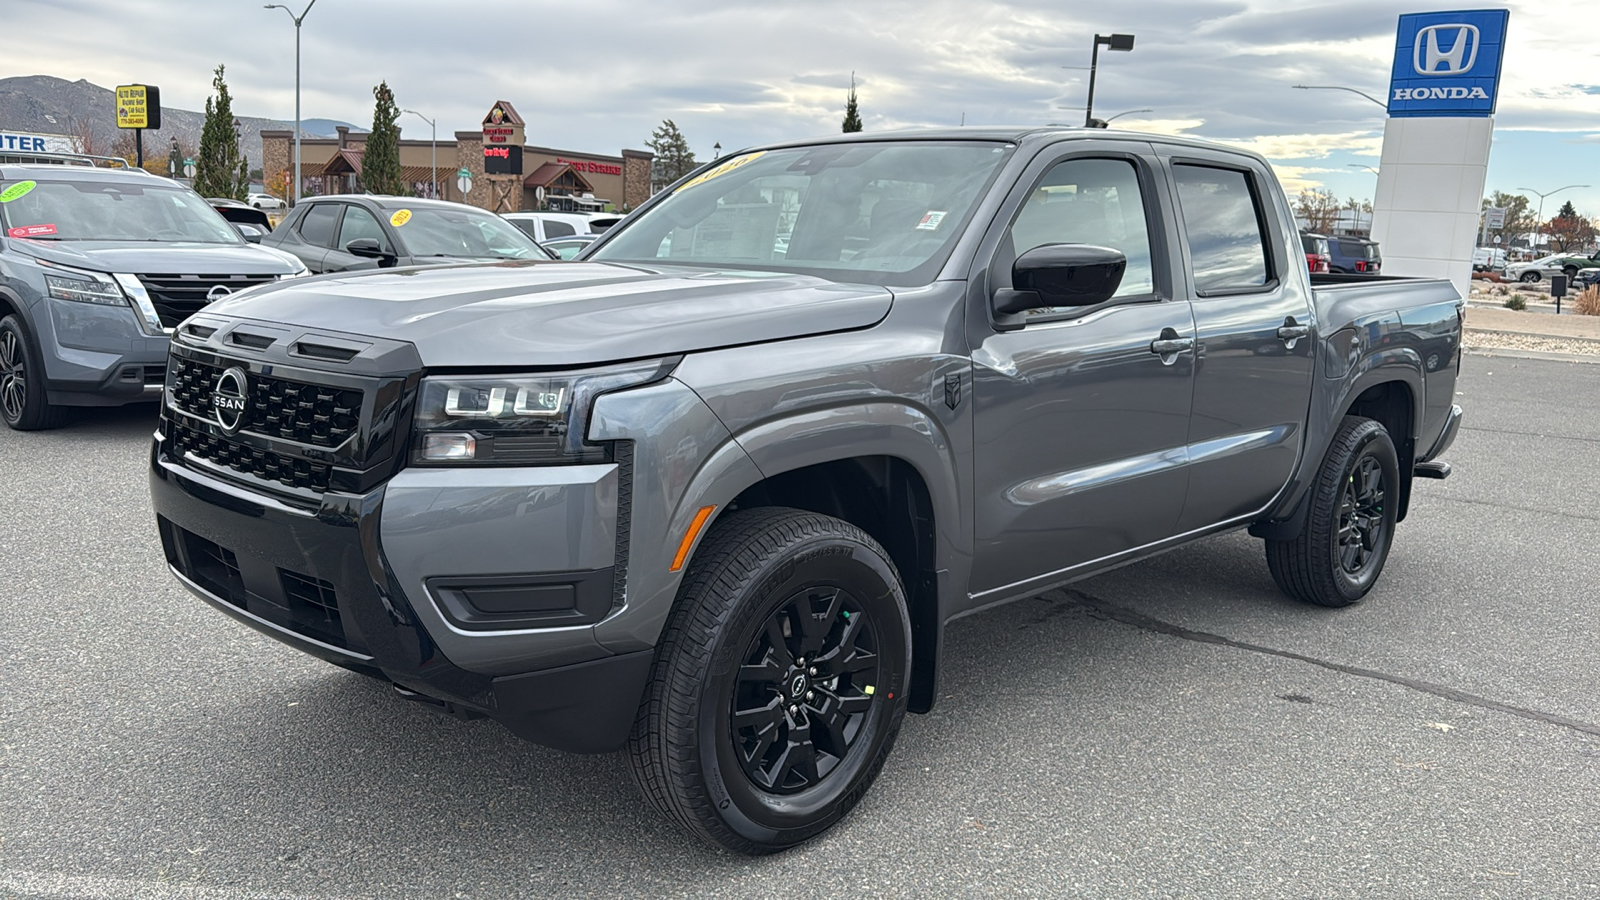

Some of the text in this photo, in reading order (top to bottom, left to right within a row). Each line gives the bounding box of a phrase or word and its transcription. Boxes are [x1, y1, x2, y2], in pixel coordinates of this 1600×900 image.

[118, 89, 145, 98] AUTO REPAIR
[1393, 86, 1489, 100] HONDA
[588, 161, 621, 176] STRIKE
[214, 395, 245, 410] SSAN
